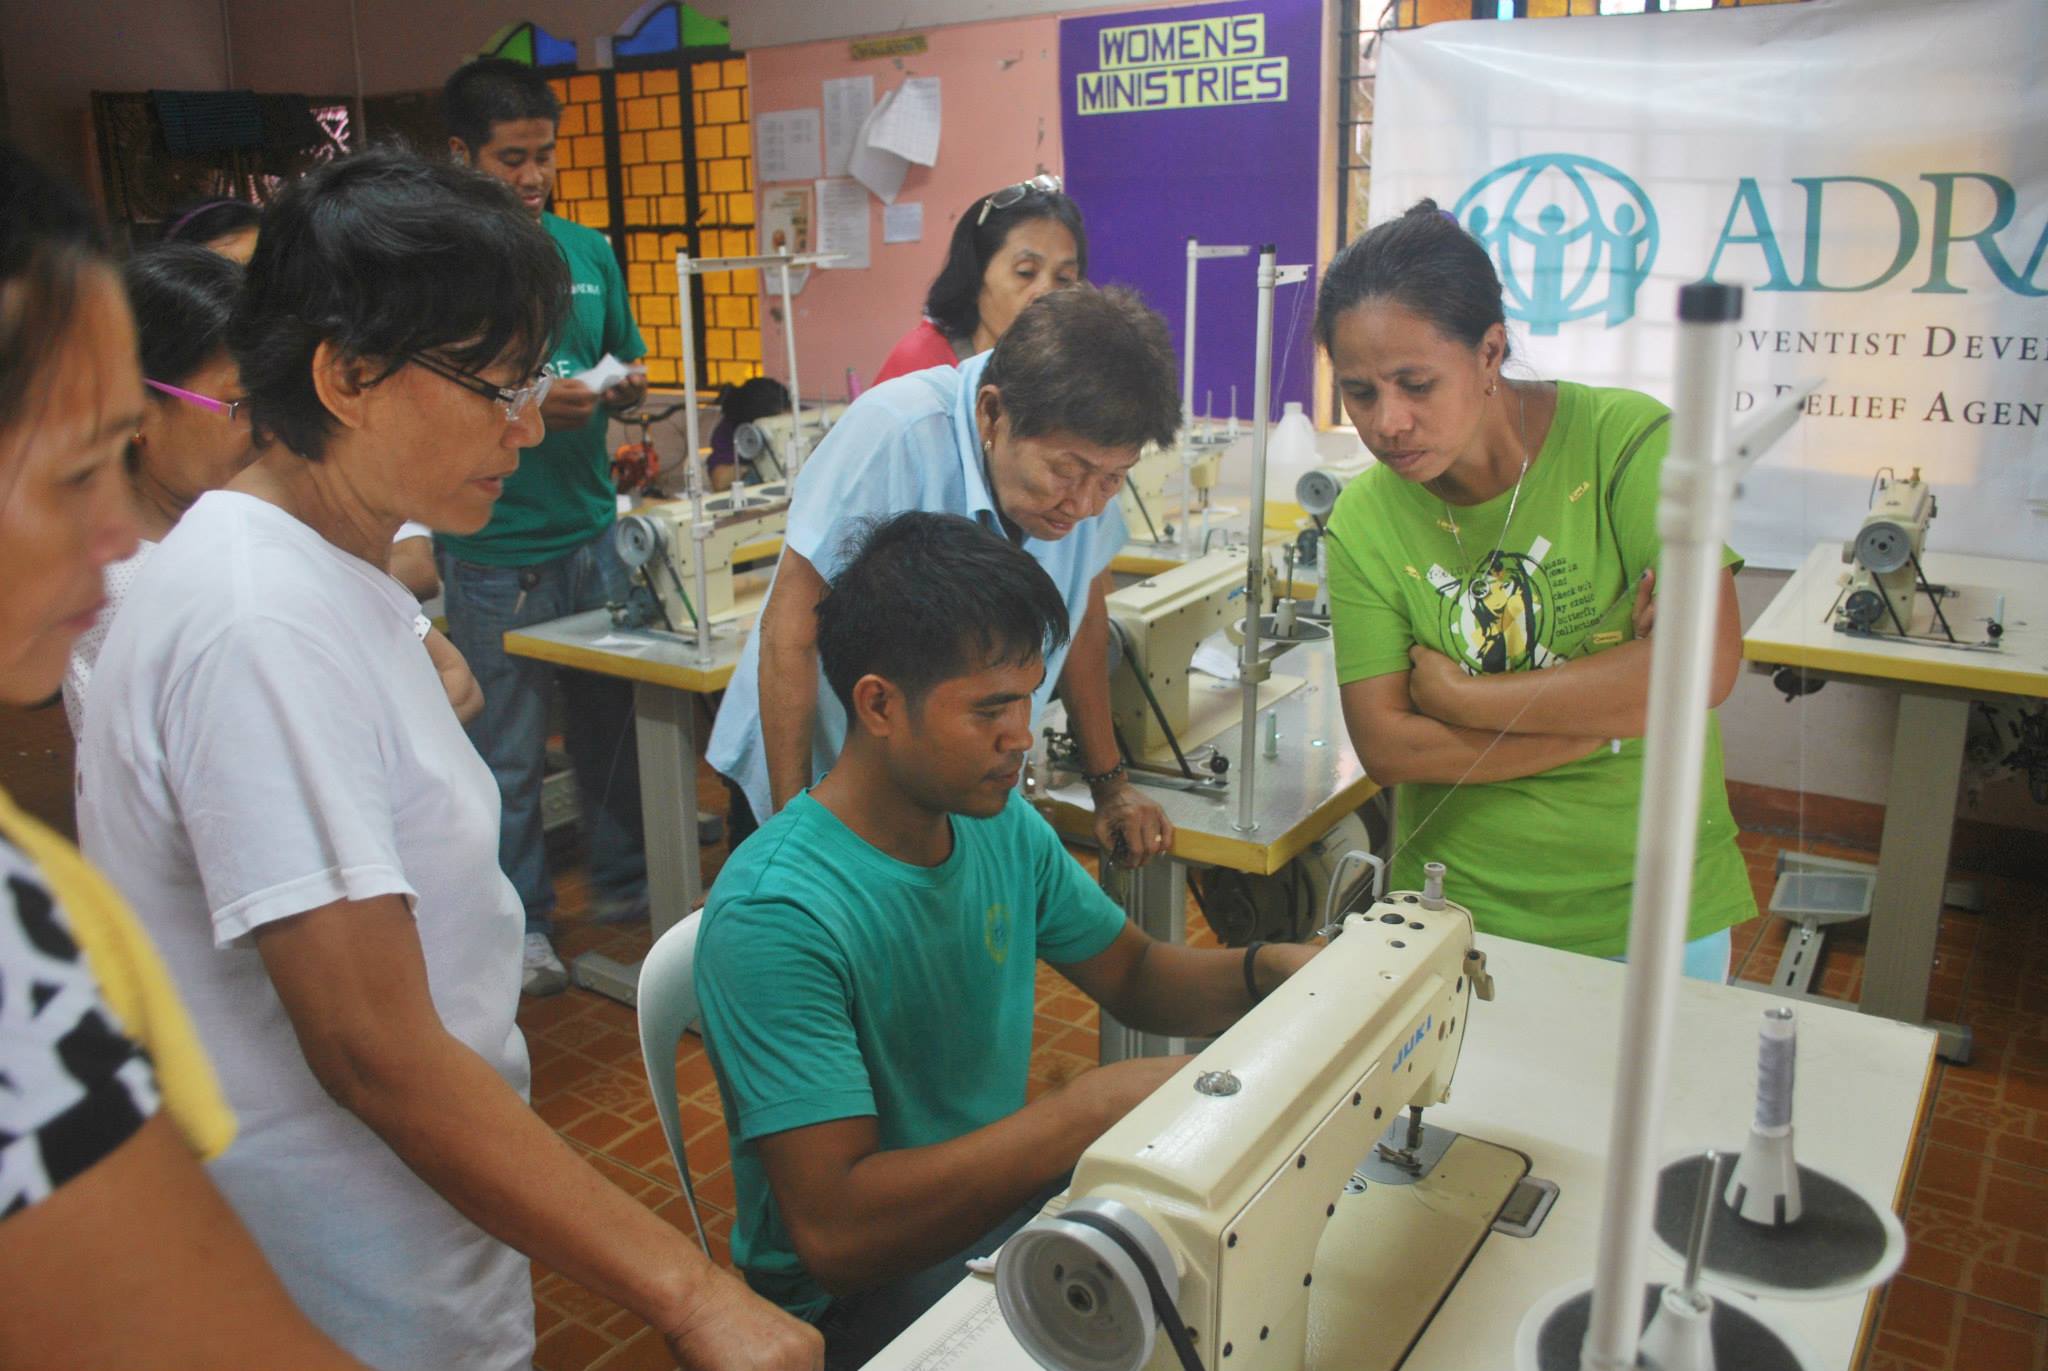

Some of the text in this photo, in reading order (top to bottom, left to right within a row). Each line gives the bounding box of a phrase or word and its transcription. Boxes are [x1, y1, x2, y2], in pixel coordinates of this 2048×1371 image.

[1102, 18, 1258, 65] WOMENS
[1081, 62, 1282, 111] MINISTRIES
[1684, 171, 2048, 297] ADR
[1736, 325, 2048, 361] VENTIST DEVE
[1774, 384, 1907, 420] ELIEF
